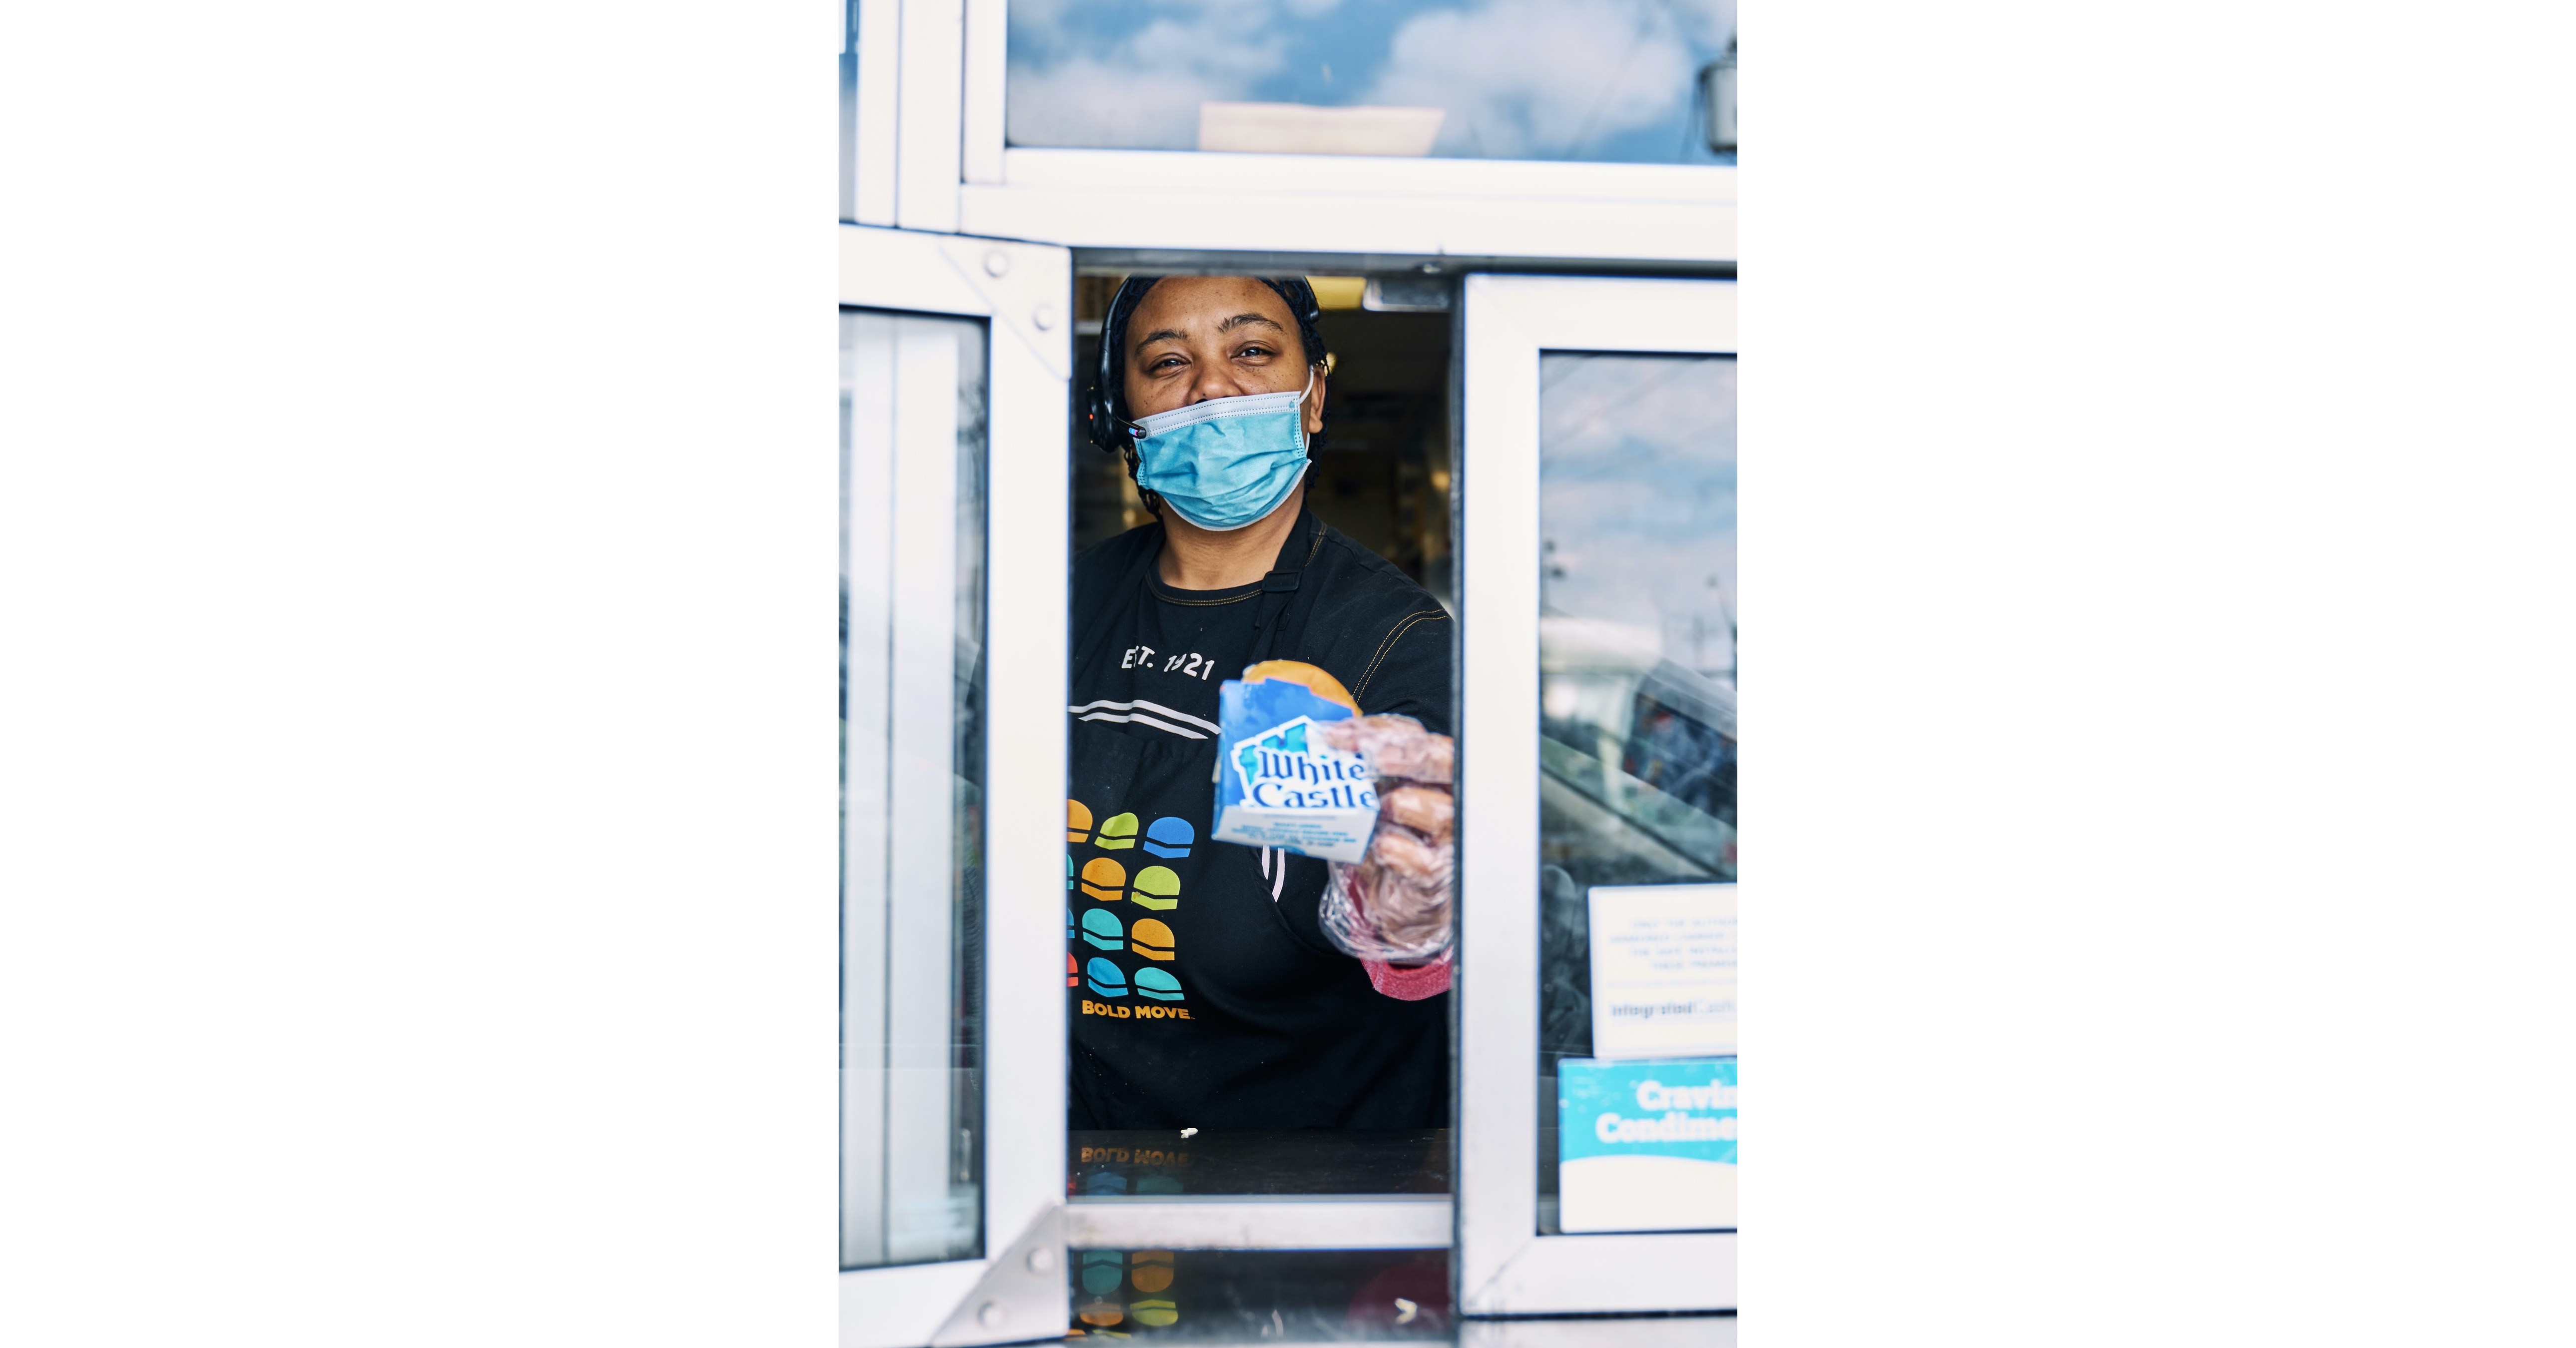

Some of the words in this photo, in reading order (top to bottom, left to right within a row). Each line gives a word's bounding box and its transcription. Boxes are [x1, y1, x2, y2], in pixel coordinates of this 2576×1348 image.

[1121, 645, 1155, 669] ET.
[1163, 652, 1215, 681] 1921
[1258, 750, 1365, 786] White
[1252, 782, 1377, 809] Castle
[1082, 1000, 1131, 1019] BOLD
[1134, 1005, 1191, 1019] MOVE
